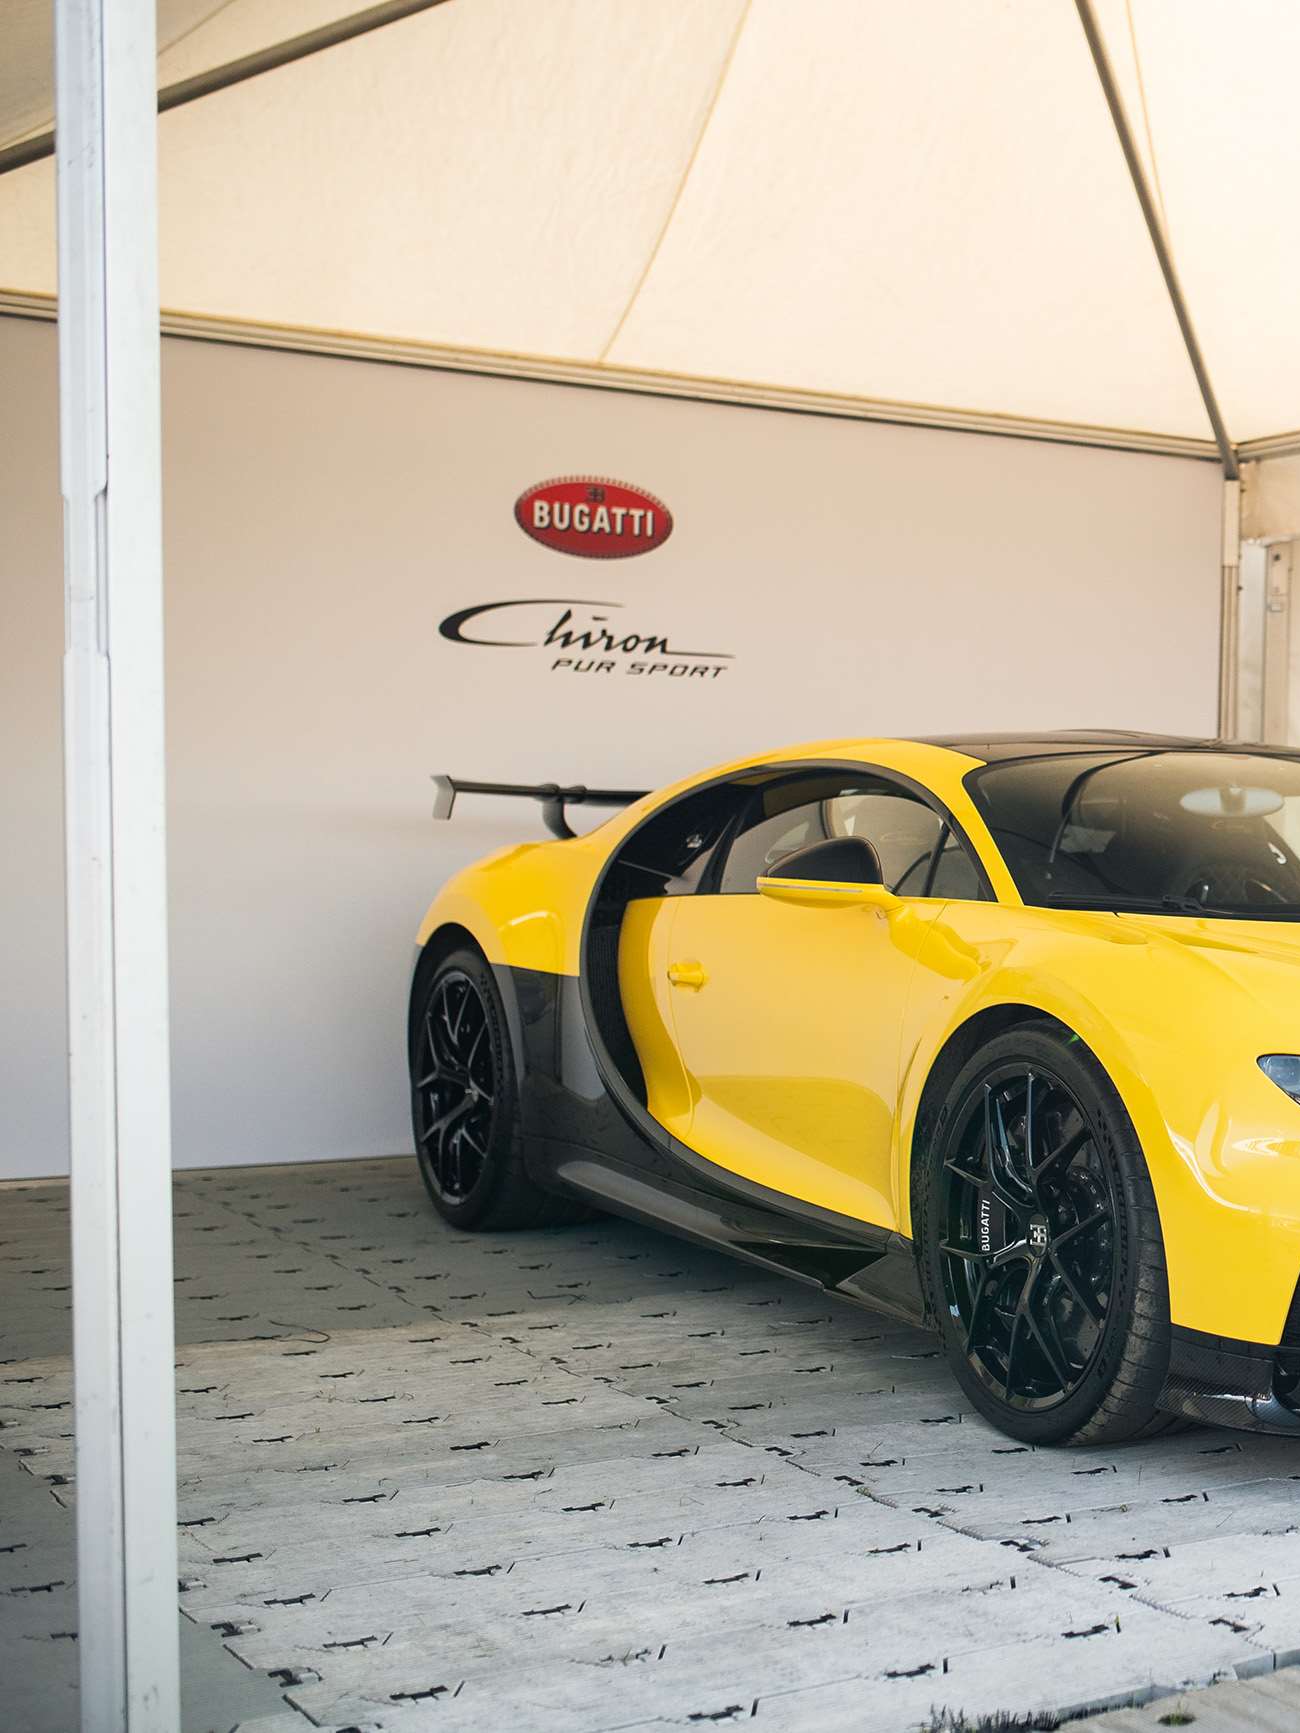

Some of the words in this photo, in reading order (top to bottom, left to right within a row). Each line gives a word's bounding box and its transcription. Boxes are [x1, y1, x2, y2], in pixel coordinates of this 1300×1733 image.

[533, 499, 654, 537] BUGATTI
[438, 599, 736, 658] Chiron
[551, 658, 616, 674] PUR
[626, 661, 728, 679] SPORT
[980, 1199, 991, 1251] BUGATTI
